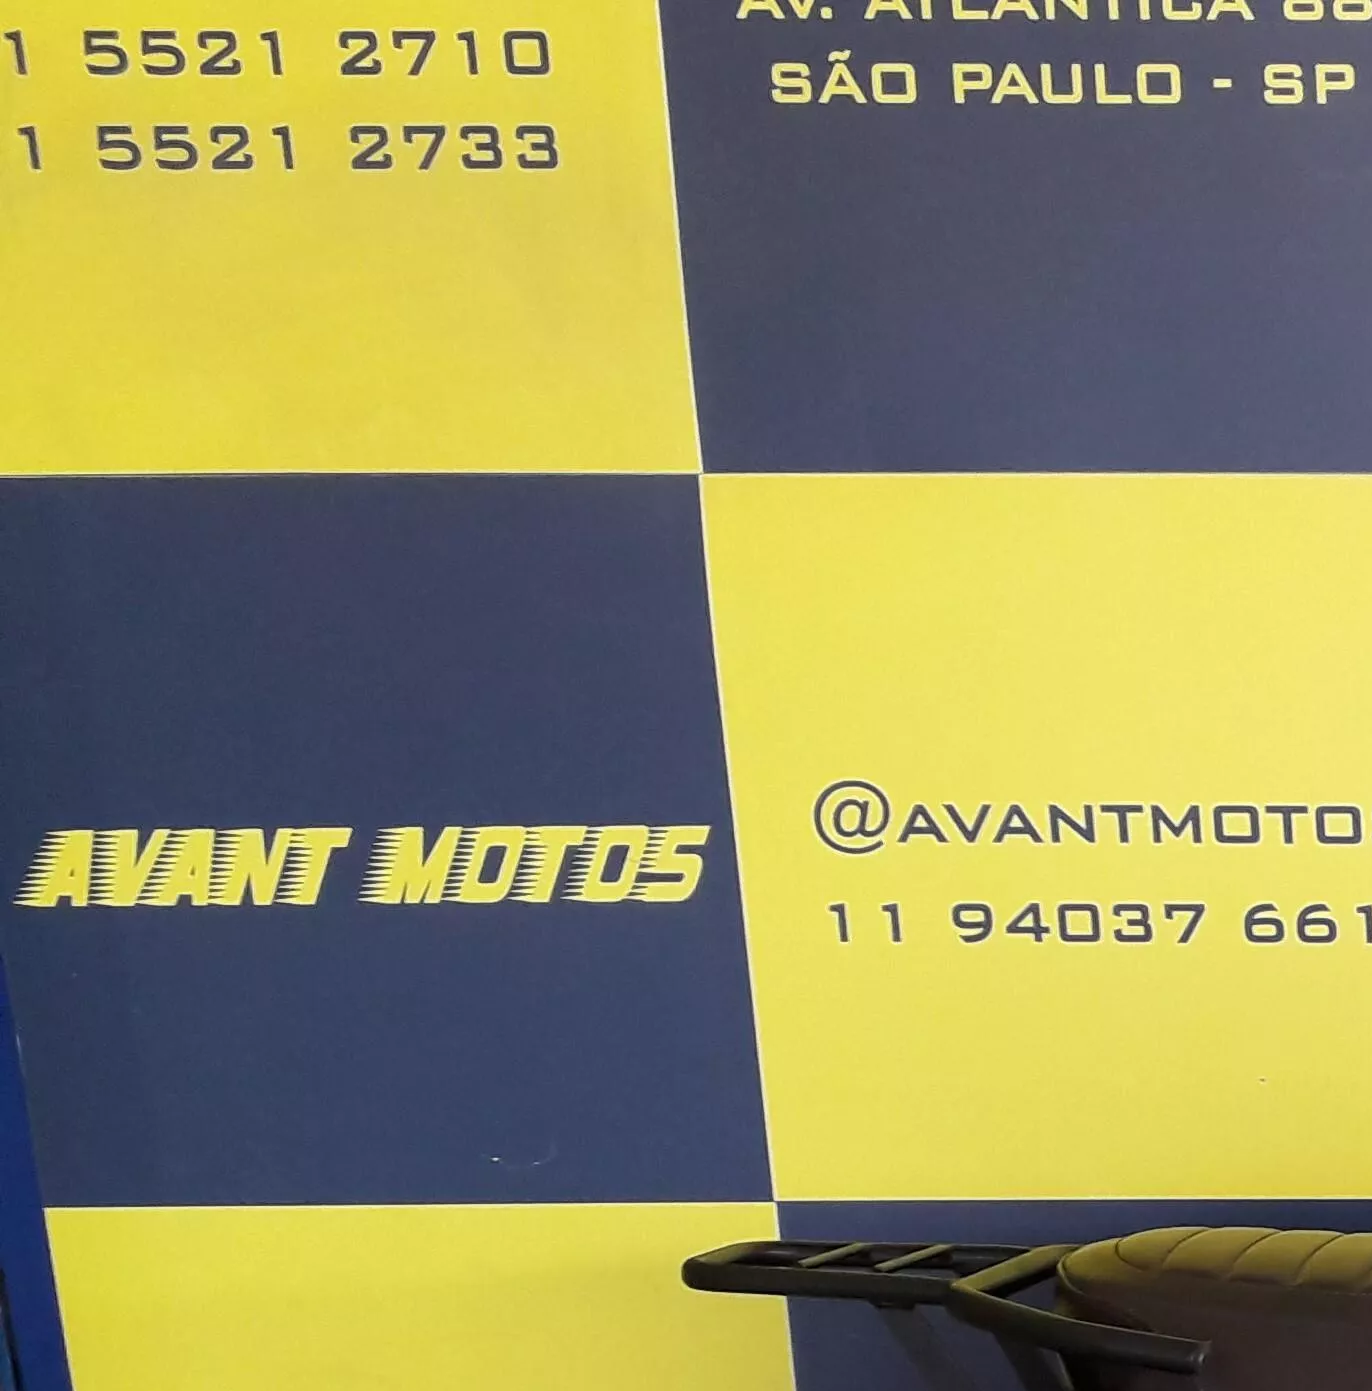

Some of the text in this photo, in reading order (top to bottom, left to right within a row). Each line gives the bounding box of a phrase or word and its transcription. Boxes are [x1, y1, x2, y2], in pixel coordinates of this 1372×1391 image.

[82, 29, 284, 77] 5521
[337, 29, 551, 77] 2710
[771, 50, 1357, 105] SÃO PAULO - SP
[96, 124, 295, 172] 5521
[348, 124, 560, 171] 2733
[13, 824, 711, 907] AVANT MOTOS
[828, 902, 902, 944] 11
[951, 901, 1207, 945] 94037
